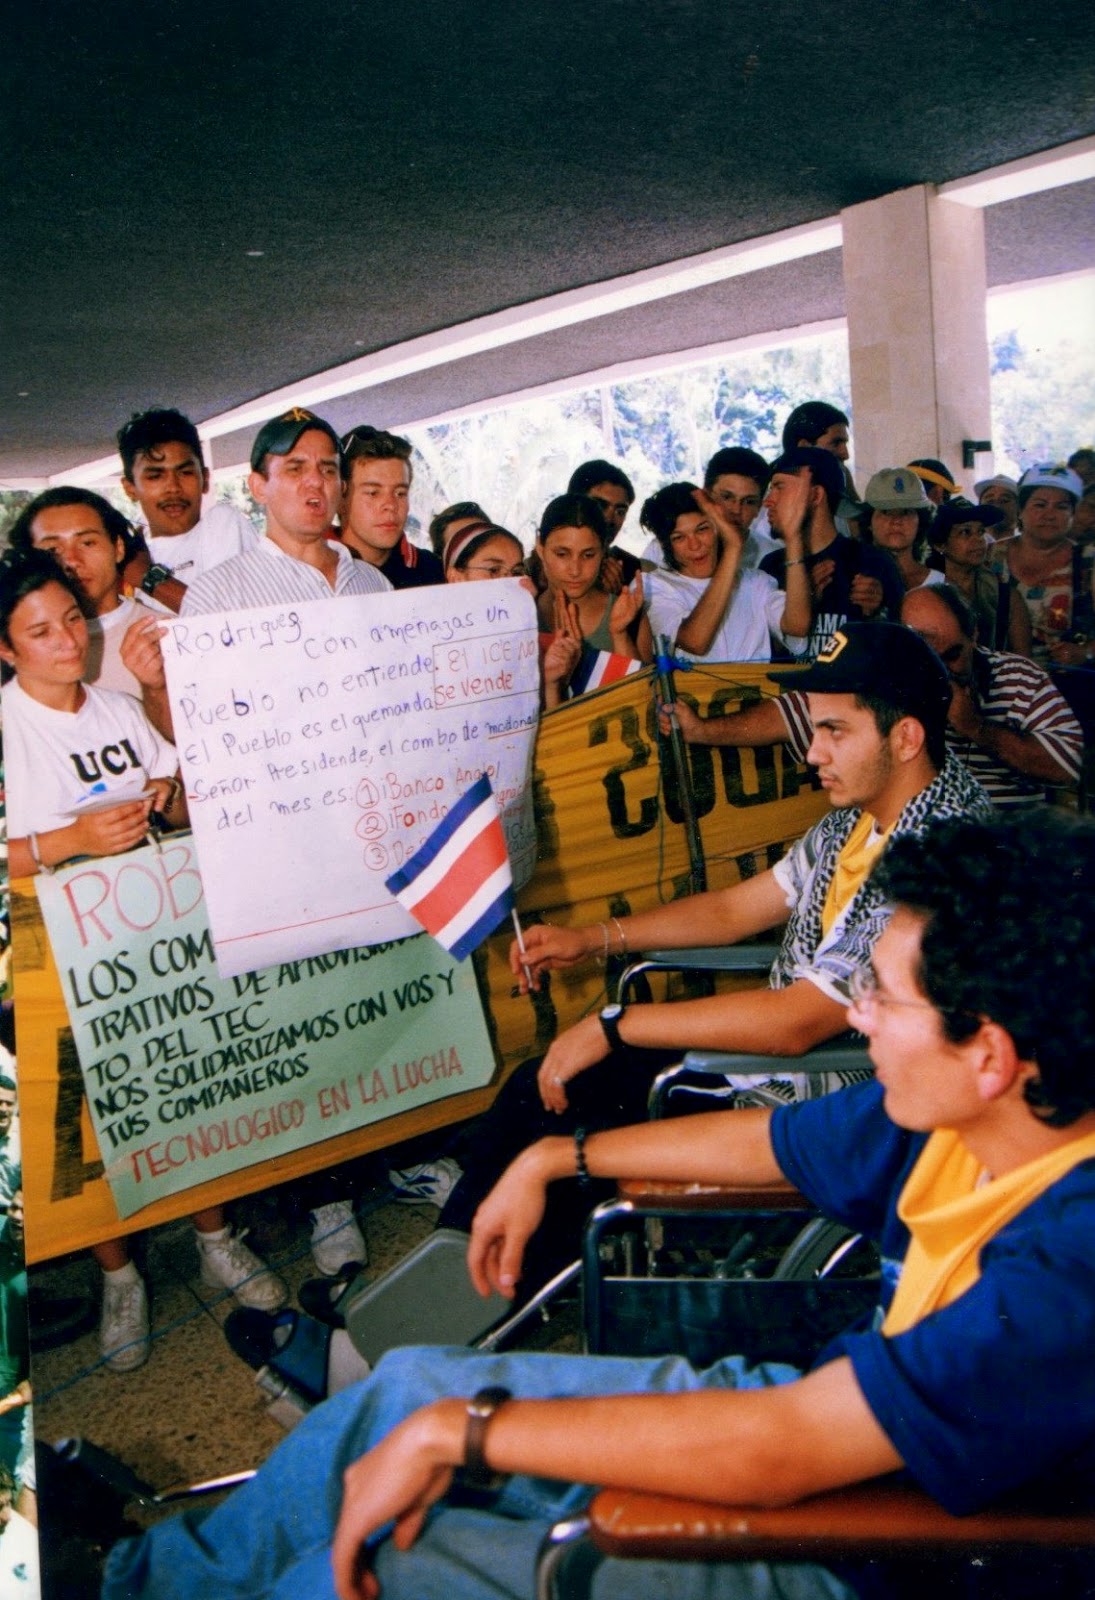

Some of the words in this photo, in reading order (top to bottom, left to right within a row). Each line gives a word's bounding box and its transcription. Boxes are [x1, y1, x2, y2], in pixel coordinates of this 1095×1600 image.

[481, 641, 512, 665] ICE
[179, 688, 275, 729] Pueblo
[298, 680, 329, 703] no
[223, 727, 292, 757] Pueblo
[302, 720, 323, 739] es
[379, 739, 393, 757] el
[401, 728, 457, 752] combo
[462, 720, 478, 741] de
[216, 806, 253, 831] del
[270, 797, 311, 817] mes
[68, 950, 137, 1008] LOS
[83, 976, 214, 1048] TRATIVOS
[87, 1053, 130, 1087] TO
[142, 1028, 199, 1069] DEL
[200, 1001, 270, 1043] TEC
[94, 1076, 149, 1120] NOS
[154, 1009, 339, 1096] SOLIDARIZAMOS
[344, 990, 388, 1031] CON
[393, 973, 434, 1012] VOS
[437, 968, 454, 996] Y
[101, 1110, 150, 1148] TUS
[157, 1052, 309, 1124] COMPAÑEROS
[131, 1098, 305, 1183] TECNOLOGICO
[317, 1078, 351, 1120] EN
[358, 1068, 390, 1104] LA
[392, 1046, 465, 1095] LUCHA
